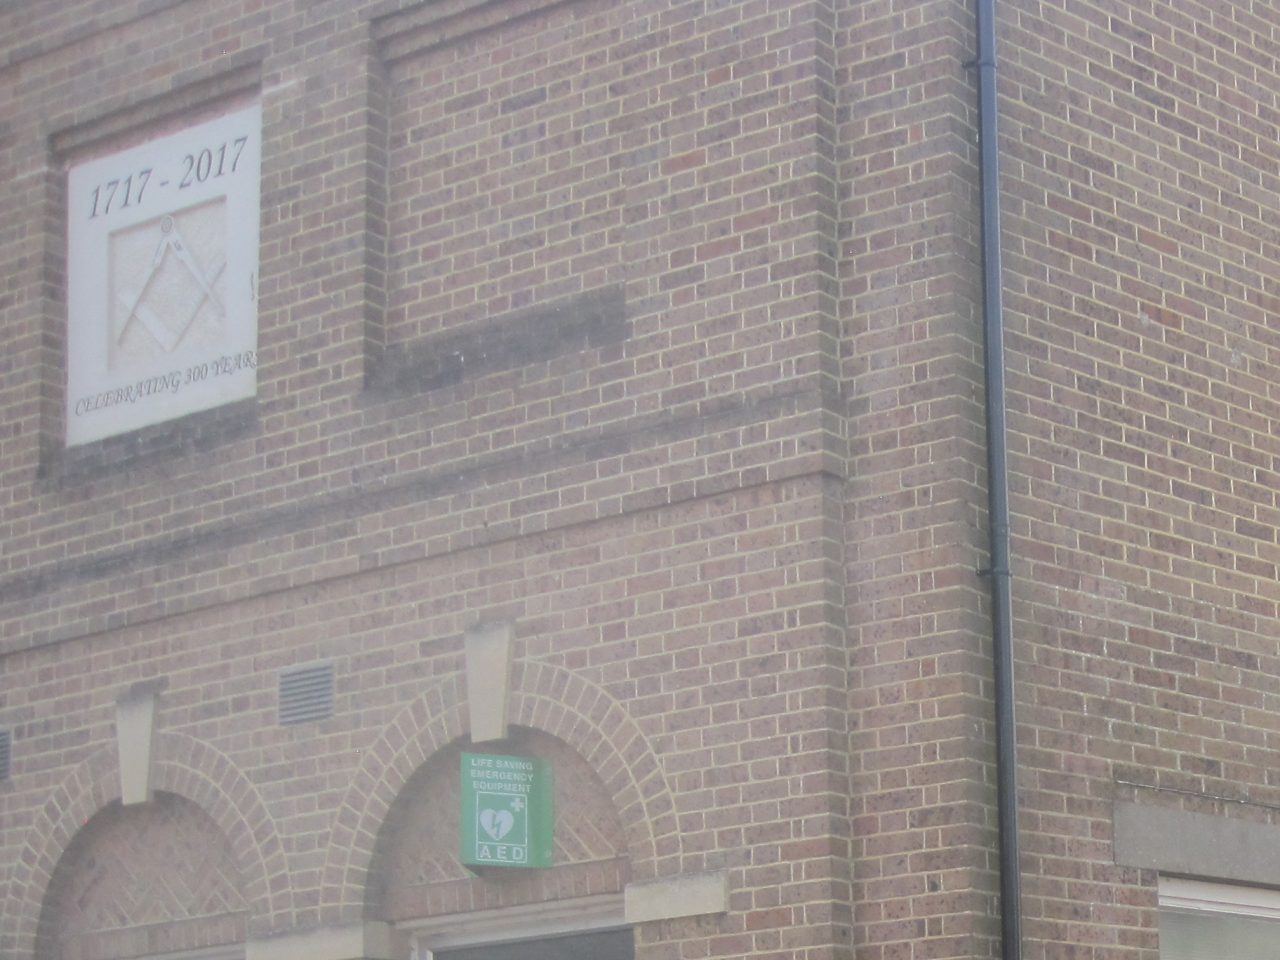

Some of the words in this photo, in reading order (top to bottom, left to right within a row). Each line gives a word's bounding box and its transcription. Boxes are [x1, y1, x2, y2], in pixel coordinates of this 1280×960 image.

[89, 168, 152, 220] 1717
[178, 136, 248, 189] 2017
[75, 370, 182, 417] CELEBRATING
[184, 362, 208, 386] 300
[471, 758, 493, 768] LIFE
[495, 759, 533, 770] SAVING
[470, 769, 534, 782] EMERGENCY
[472, 780, 533, 793] EQUIPMENT
[480, 845, 524, 860] AED
